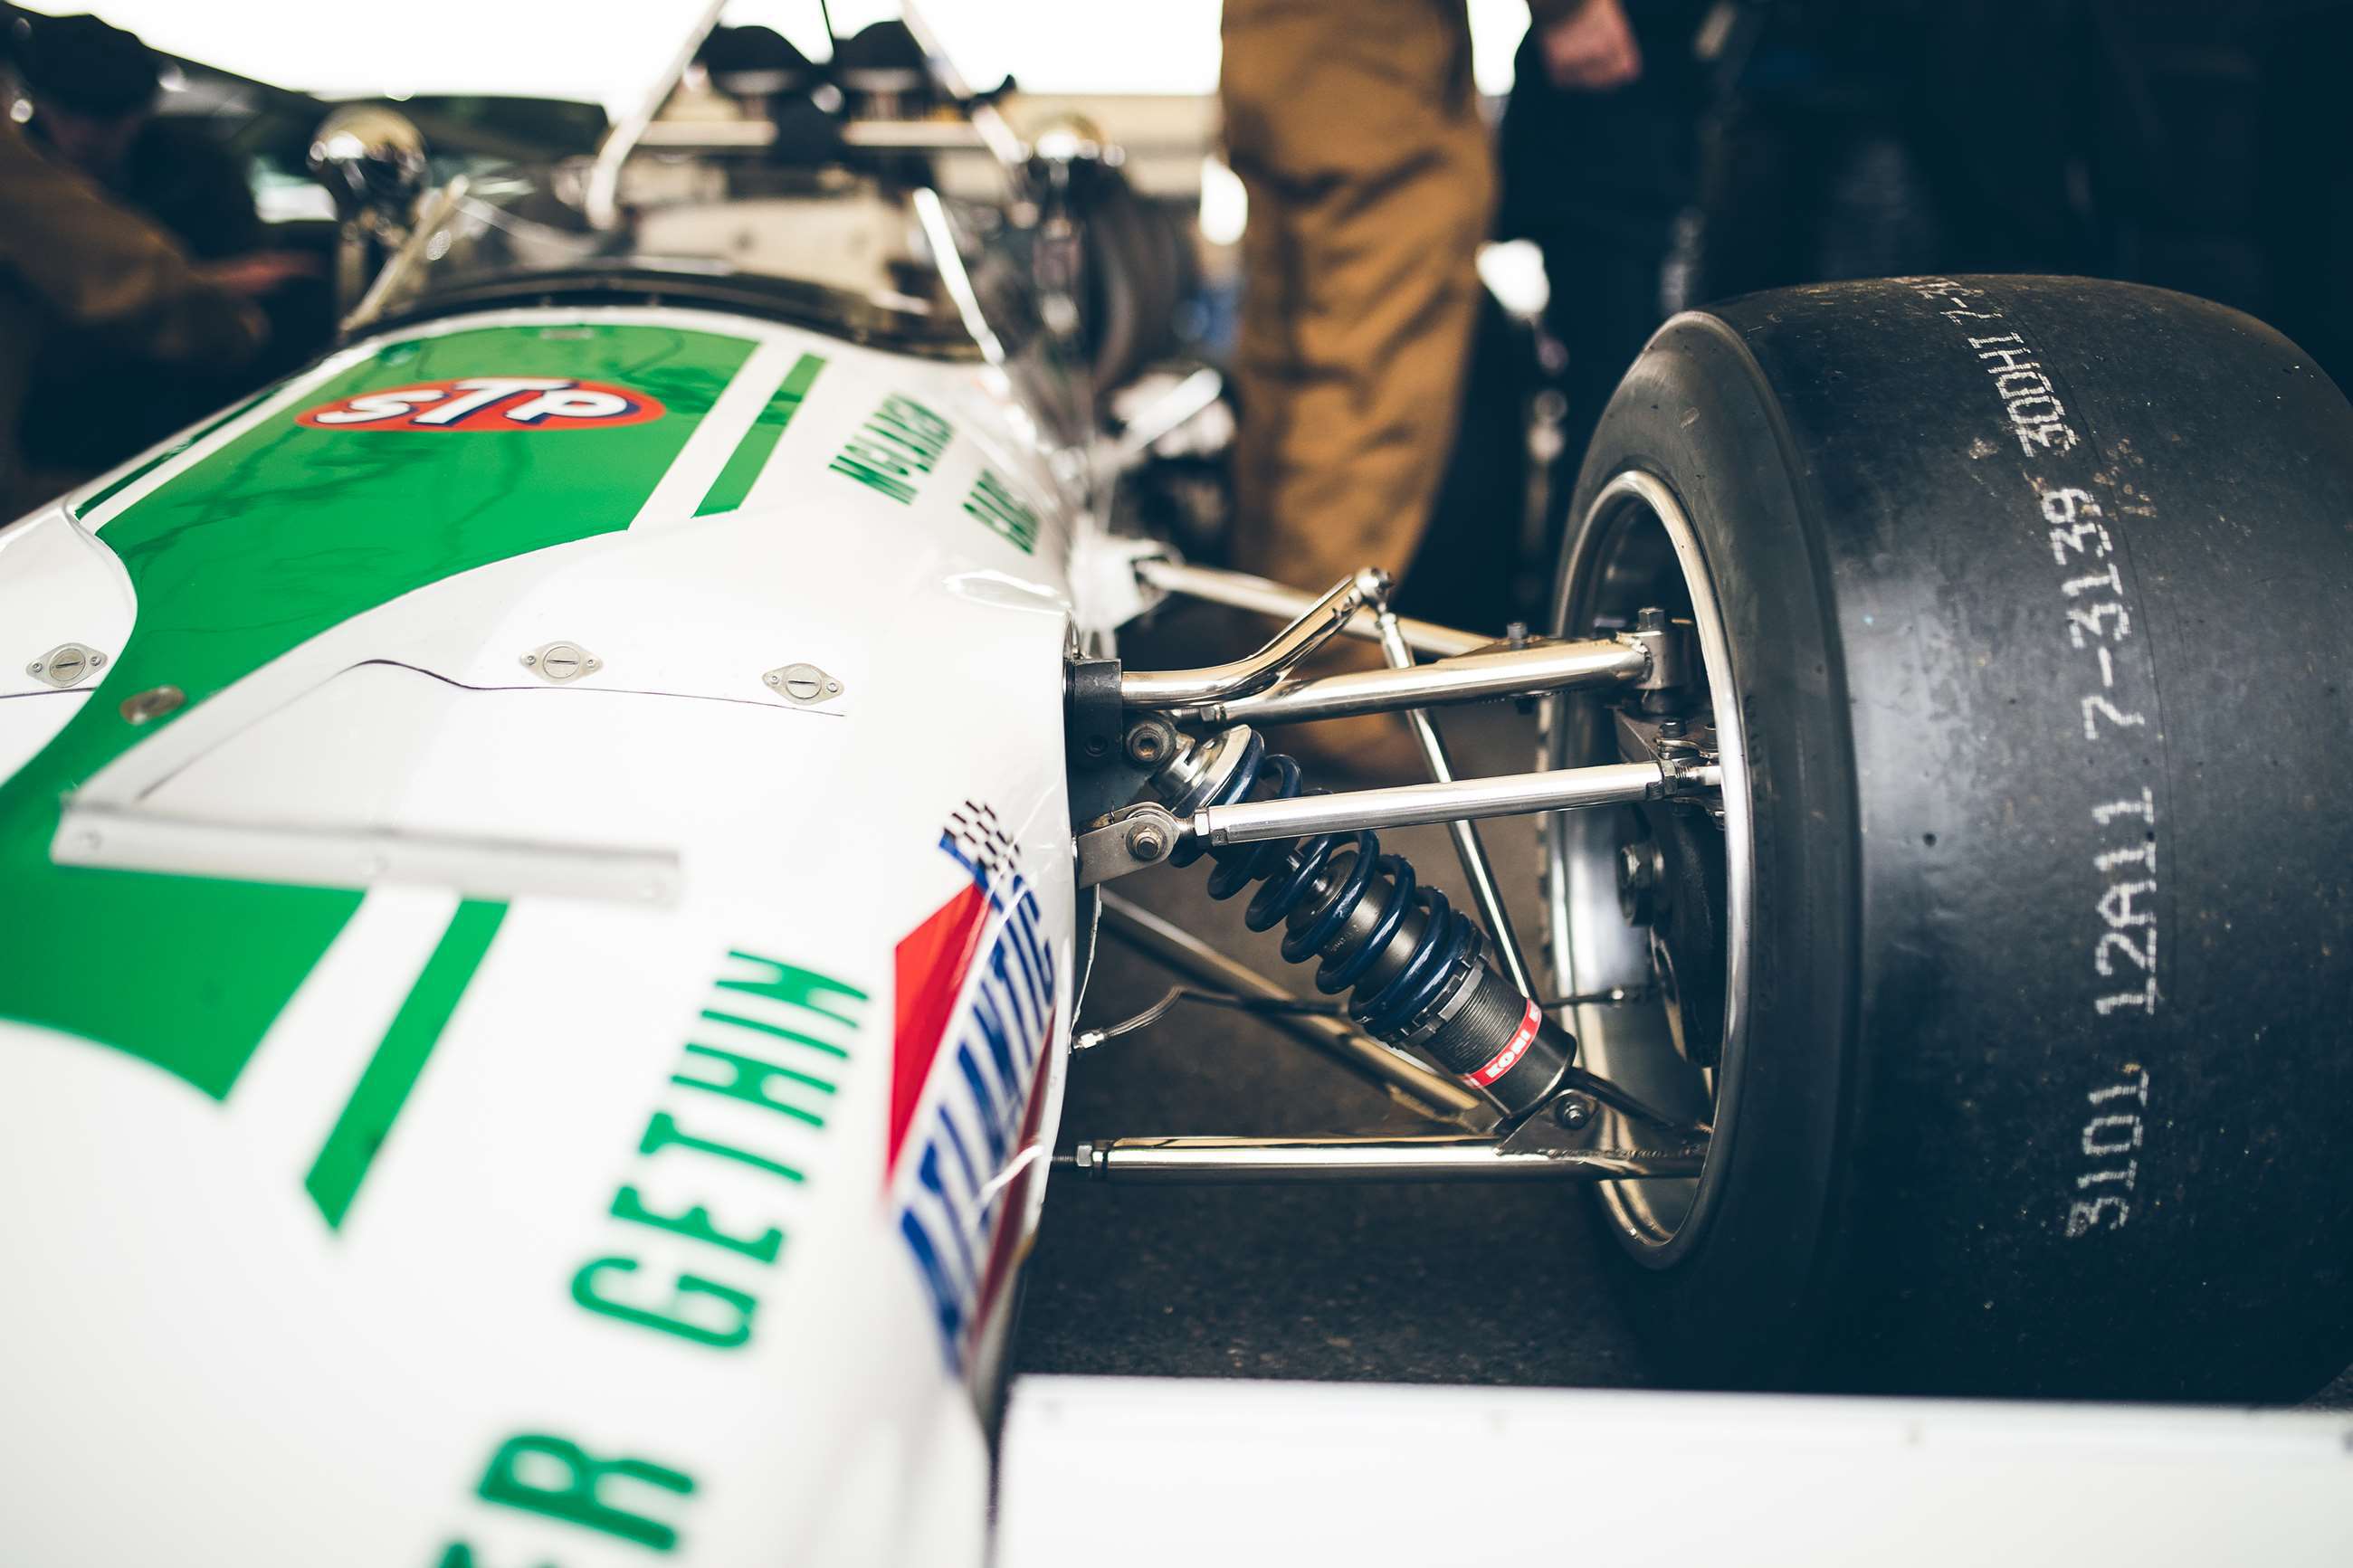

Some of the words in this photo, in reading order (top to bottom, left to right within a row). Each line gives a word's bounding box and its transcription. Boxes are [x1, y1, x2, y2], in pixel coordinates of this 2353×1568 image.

[314, 377, 638, 427] STP
[2042, 488, 2145, 741] 7-3139
[2092, 786, 2157, 1015] 12A11
[1484, 1028, 1531, 1079] KONI
[436, 1433, 695, 1568] R
[570, 949, 869, 1348] GETHIN
